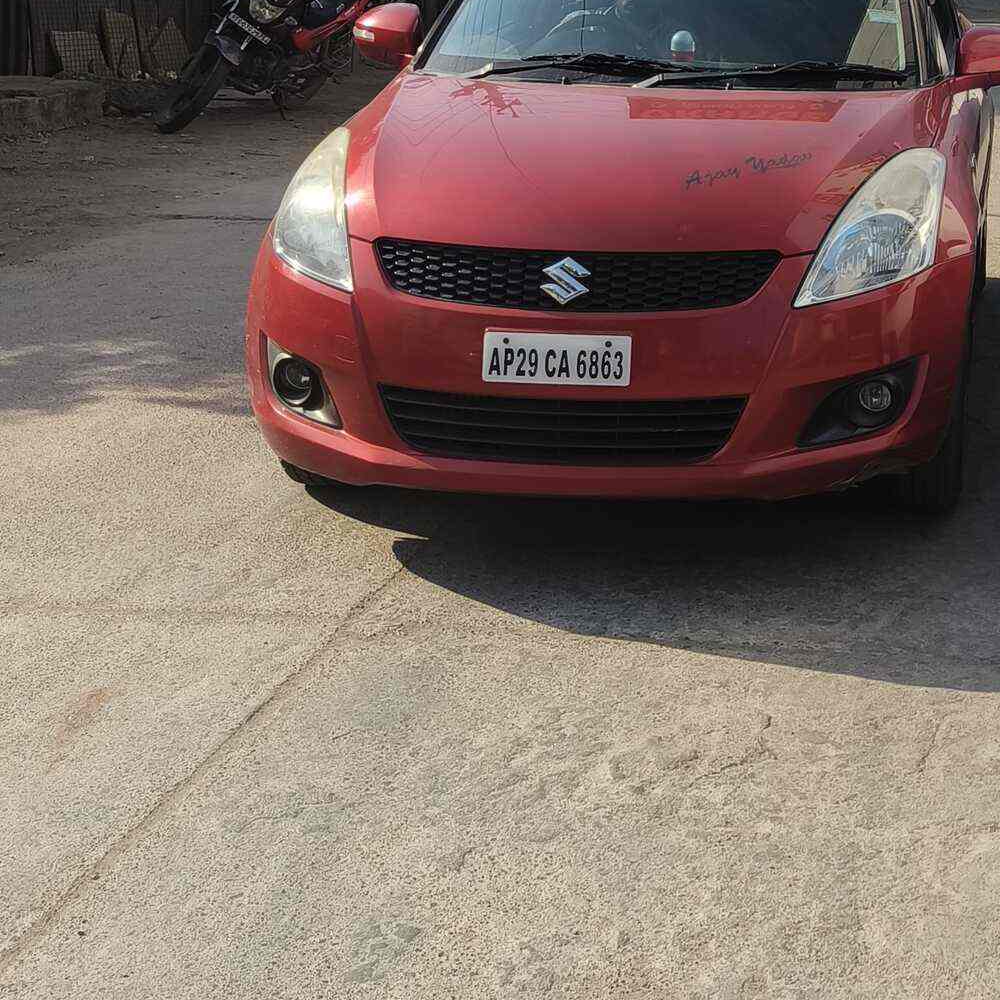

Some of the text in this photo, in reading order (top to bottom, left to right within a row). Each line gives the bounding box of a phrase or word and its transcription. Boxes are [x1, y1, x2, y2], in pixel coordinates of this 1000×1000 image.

[686, 168, 741, 191] Ajay
[488, 347, 624, 380] AP29 CA 6863
